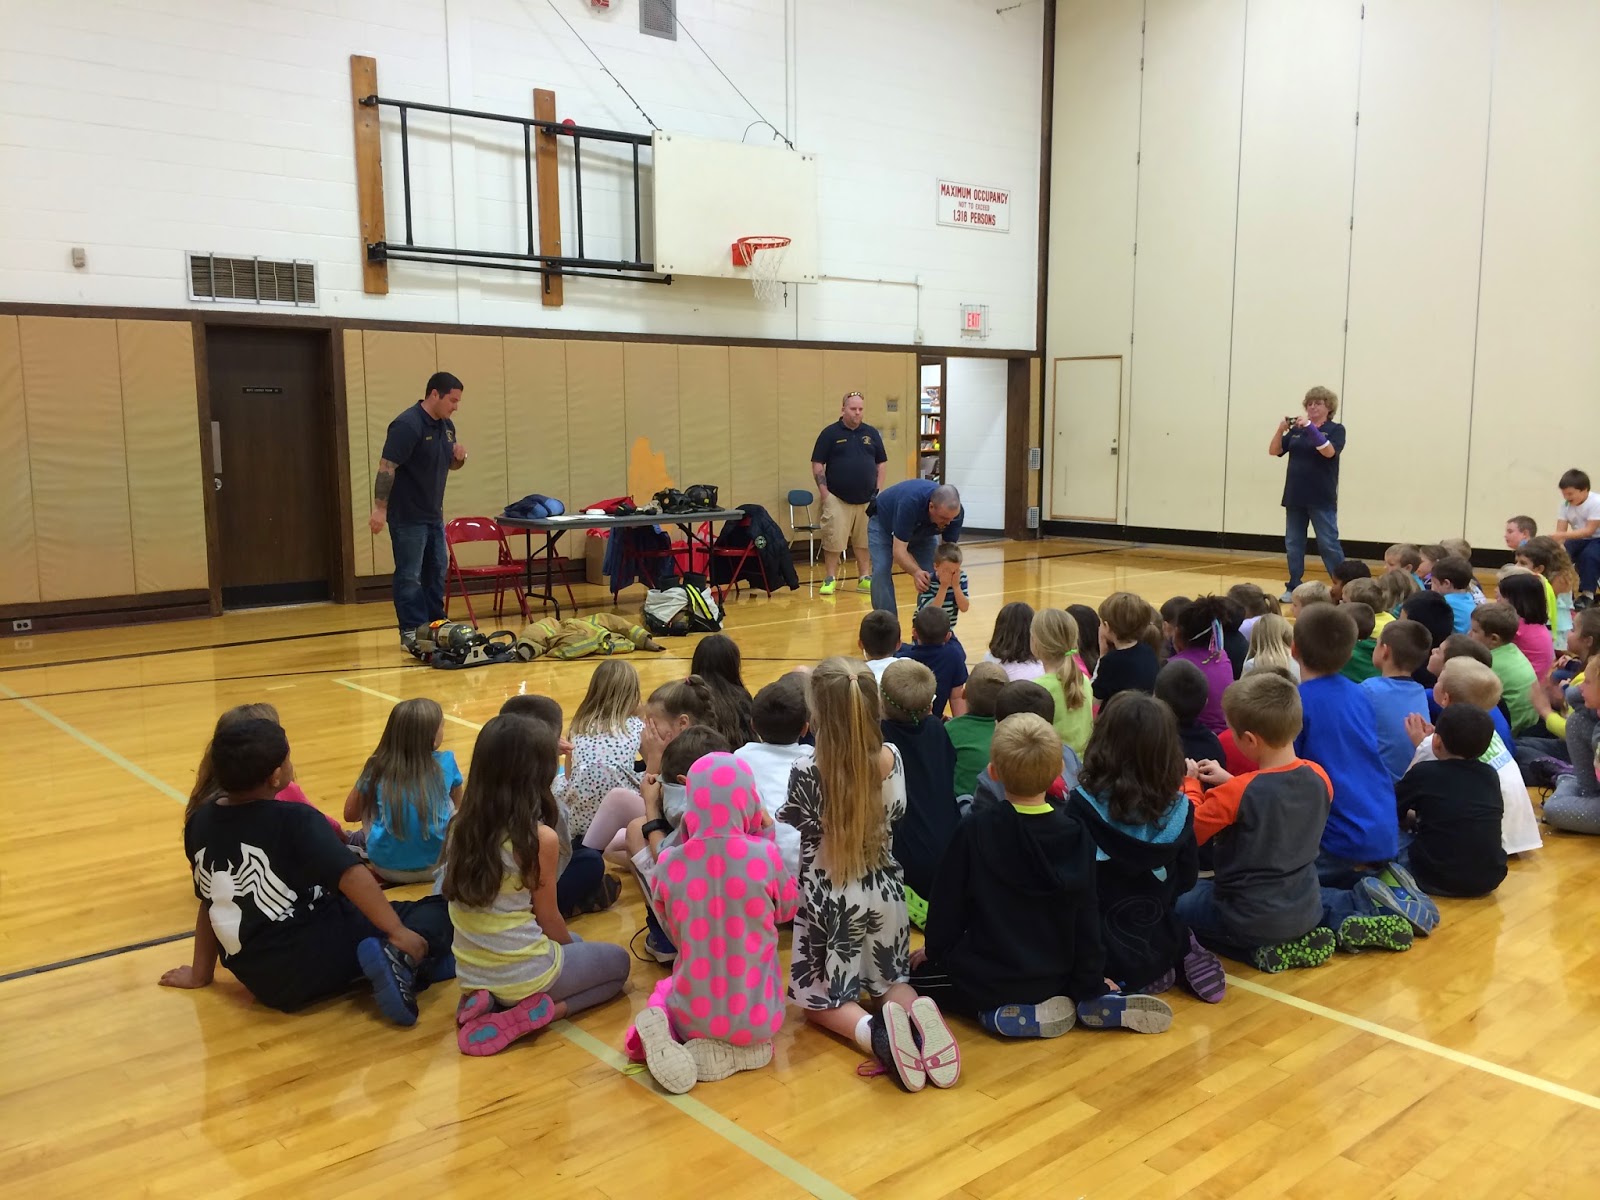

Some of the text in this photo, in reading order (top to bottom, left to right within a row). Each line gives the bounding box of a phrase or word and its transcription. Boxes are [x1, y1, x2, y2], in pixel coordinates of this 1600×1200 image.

[941, 184, 1008, 204] MAXIMUM OCCUPANCY
[970, 211, 996, 226] PERSONS
[967, 312, 981, 328] EXIT
